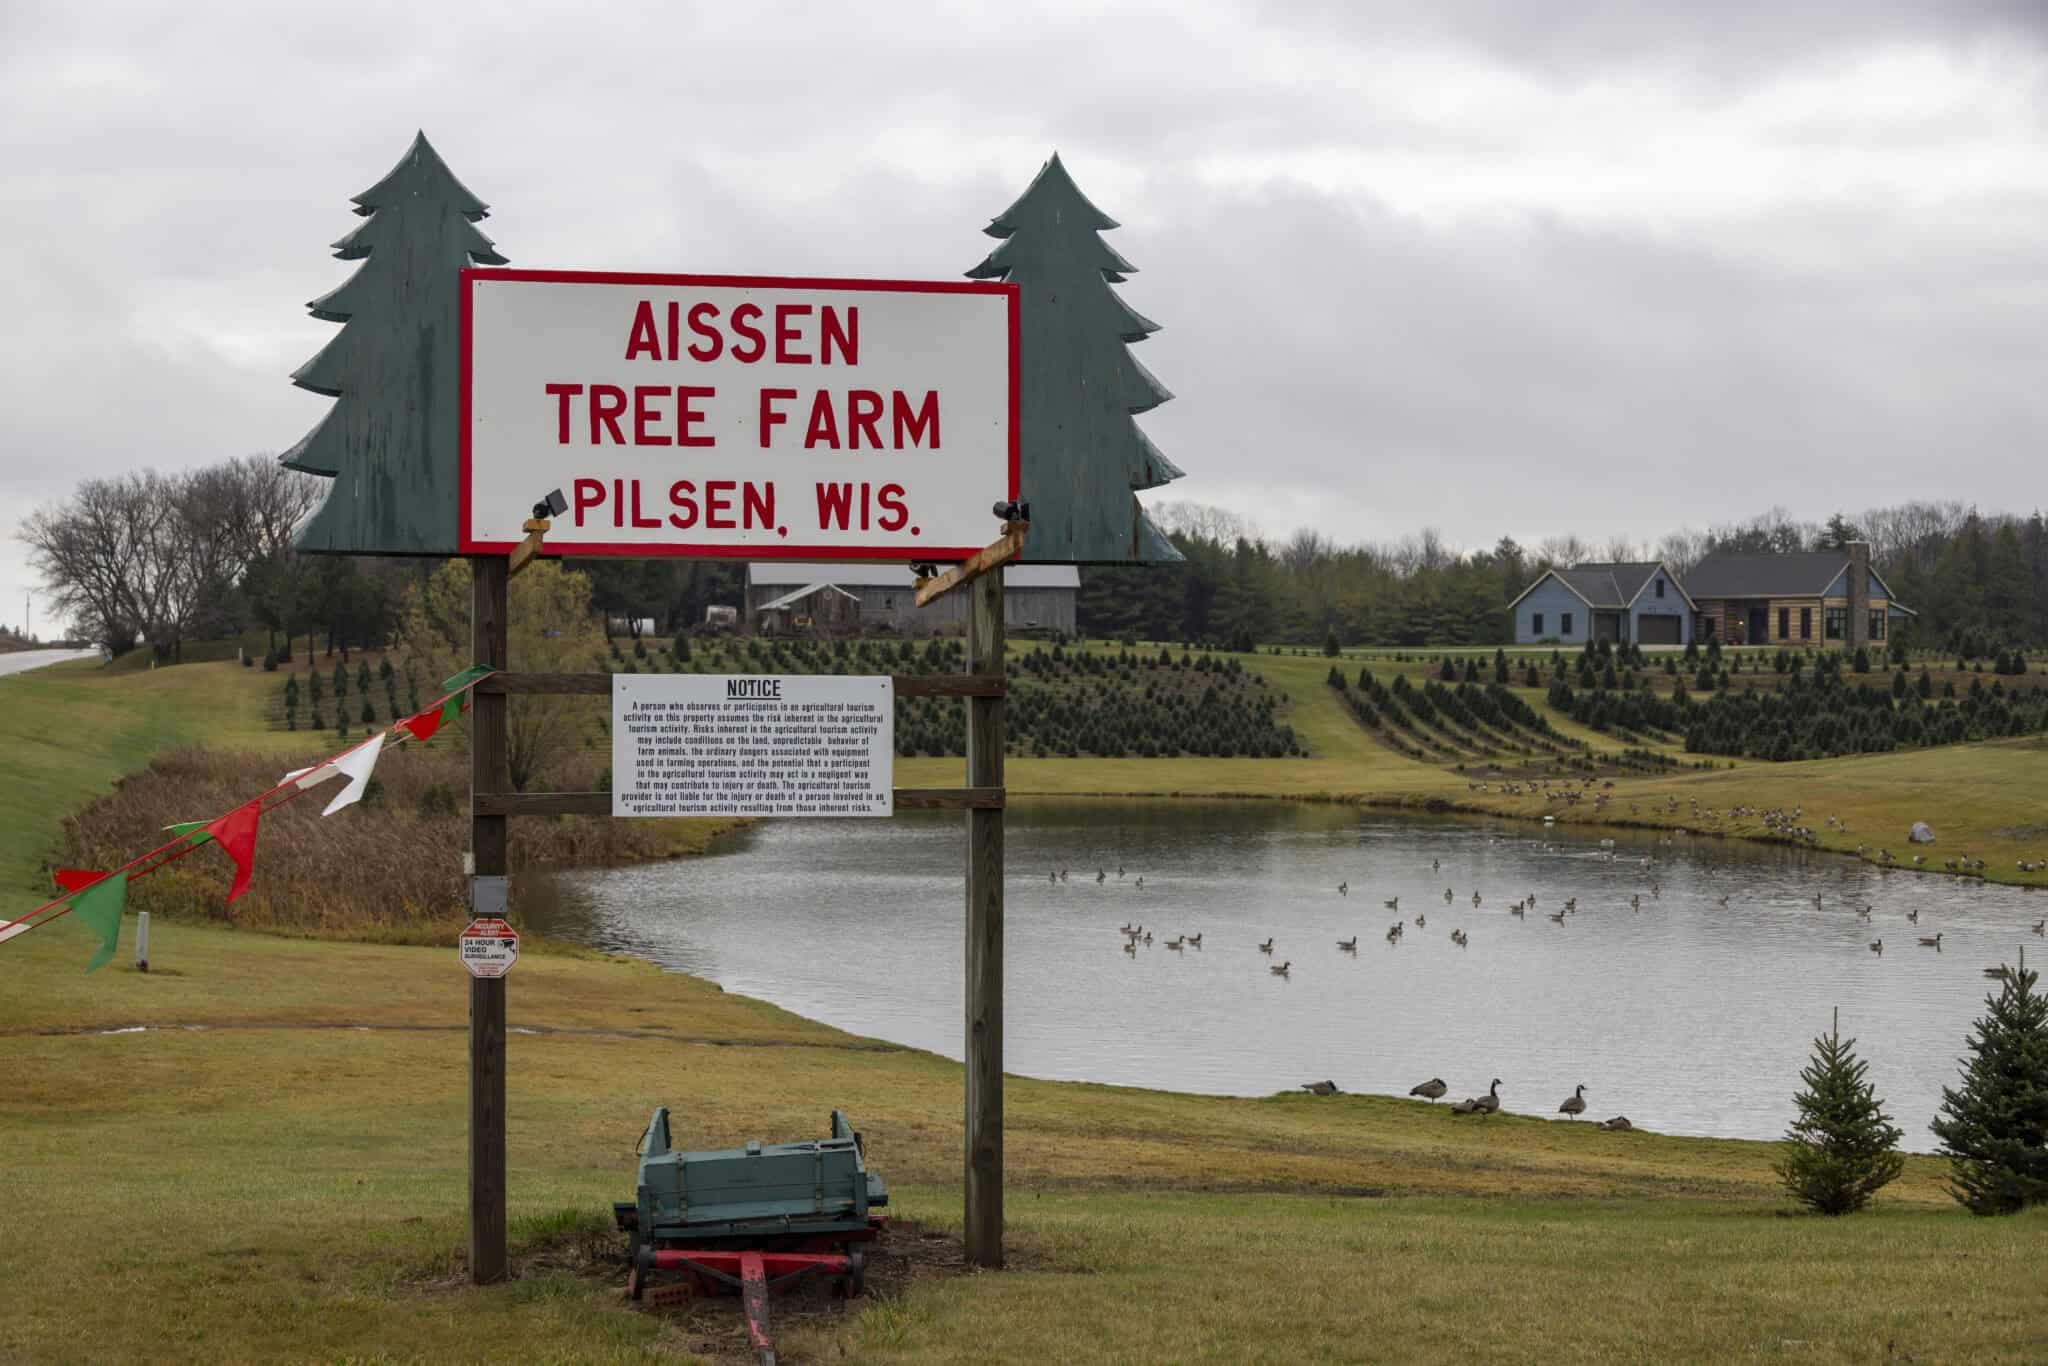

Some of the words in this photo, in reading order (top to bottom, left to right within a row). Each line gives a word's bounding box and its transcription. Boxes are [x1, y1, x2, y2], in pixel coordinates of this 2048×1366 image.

[625, 300, 858, 366] AISSEN
[546, 383, 716, 447] TREE
[759, 388, 940, 449] FARM
[573, 478, 788, 538] PILSEN,
[816, 482, 921, 537] WIS.
[727, 679, 781, 697] NOTICE
[640, 704, 666, 712] person
[669, 702, 684, 711] who
[686, 702, 721, 711] observes
[733, 702, 778, 712] participates
[780, 702, 788, 711] in
[801, 703, 844, 713] agricultural
[846, 703, 875, 711] tourism
[623, 713, 652, 723] activity
[666, 713, 680, 722] this
[683, 713, 715, 723] property
[752, 714, 764, 722] the
[766, 714, 781, 722] risk
[784, 714, 815, 722] inherent
[817, 714, 824, 722] in
[826, 714, 839, 723] the
[841, 714, 884, 724] agricultural
[628, 724, 658, 733] tourism
[659, 725, 691, 735] activity.
[692, 725, 715, 733] Risks
[717, 725, 748, 733] inherent
[750, 725, 758, 733] in
[760, 725, 772, 733] the
[774, 725, 817, 735] agricultural
[819, 725, 848, 734] tourism
[850, 725, 878, 735] activity
[637, 738, 652, 746] may
[655, 736, 682, 745] include
[684, 736, 723, 745] conditions
[737, 736, 750, 745] the
[773, 736, 822, 746] unpredictable
[827, 736, 859, 745] behavior
[861, 736, 869, 745] of
[637, 747, 655, 756] farm
[691, 747, 703, 756] the
[706, 747, 737, 757] ordinary
[739, 747, 768, 757] dangers
[771, 747, 811, 756] associated
[813, 747, 829, 756] with
[831, 747, 869, 757] equipment
[636, 759, 655, 767] used
[656, 759, 664, 767] in
[666, 759, 695, 769] farming
[741, 759, 755, 767] and
[757, 759, 770, 767] the
[771, 759, 804, 769] potential
[806, 759, 821, 767] that
[830, 759, 870, 769] participant
[637, 770, 645, 778] in
[647, 770, 660, 778] the
[662, 770, 705, 780] agricultural
[707, 770, 737, 778] tourism
[739, 770, 767, 780] activity
[769, 771, 784, 780] may
[787, 770, 799, 778] act
[801, 770, 809, 778] in
[817, 770, 852, 780] negligent
[854, 771, 869, 780] way
[635, 781, 651, 789] that
[653, 782, 668, 791] may
[671, 781, 709, 789] contribute
[712, 781, 720, 790] to
[722, 781, 744, 791] injury
[746, 782, 754, 790] or
[756, 781, 778, 790] death.
[782, 781, 795, 790] The
[797, 781, 840, 791] agricultural
[842, 781, 871, 790] tourism
[621, 792, 653, 802] provider
[655, 792, 662, 801] is
[664, 792, 677, 801] not
[679, 792, 700, 801] liable
[702, 792, 714, 801] for
[716, 792, 729, 801] the
[730, 792, 752, 802] injury
[765, 792, 786, 801] death
[788, 792, 796, 801] of
[805, 794, 831, 802] person
[832, 792, 864, 801] involved
[865, 792, 873, 801] in
[632, 803, 677, 813] agricultural
[678, 803, 708, 812] tourism
[709, 803, 738, 813] activity
[739, 803, 774, 813] resulting
[775, 803, 794, 812] from
[795, 803, 817, 812] those
[818, 803, 849, 812] inherent
[851, 803, 873, 812] risks.
